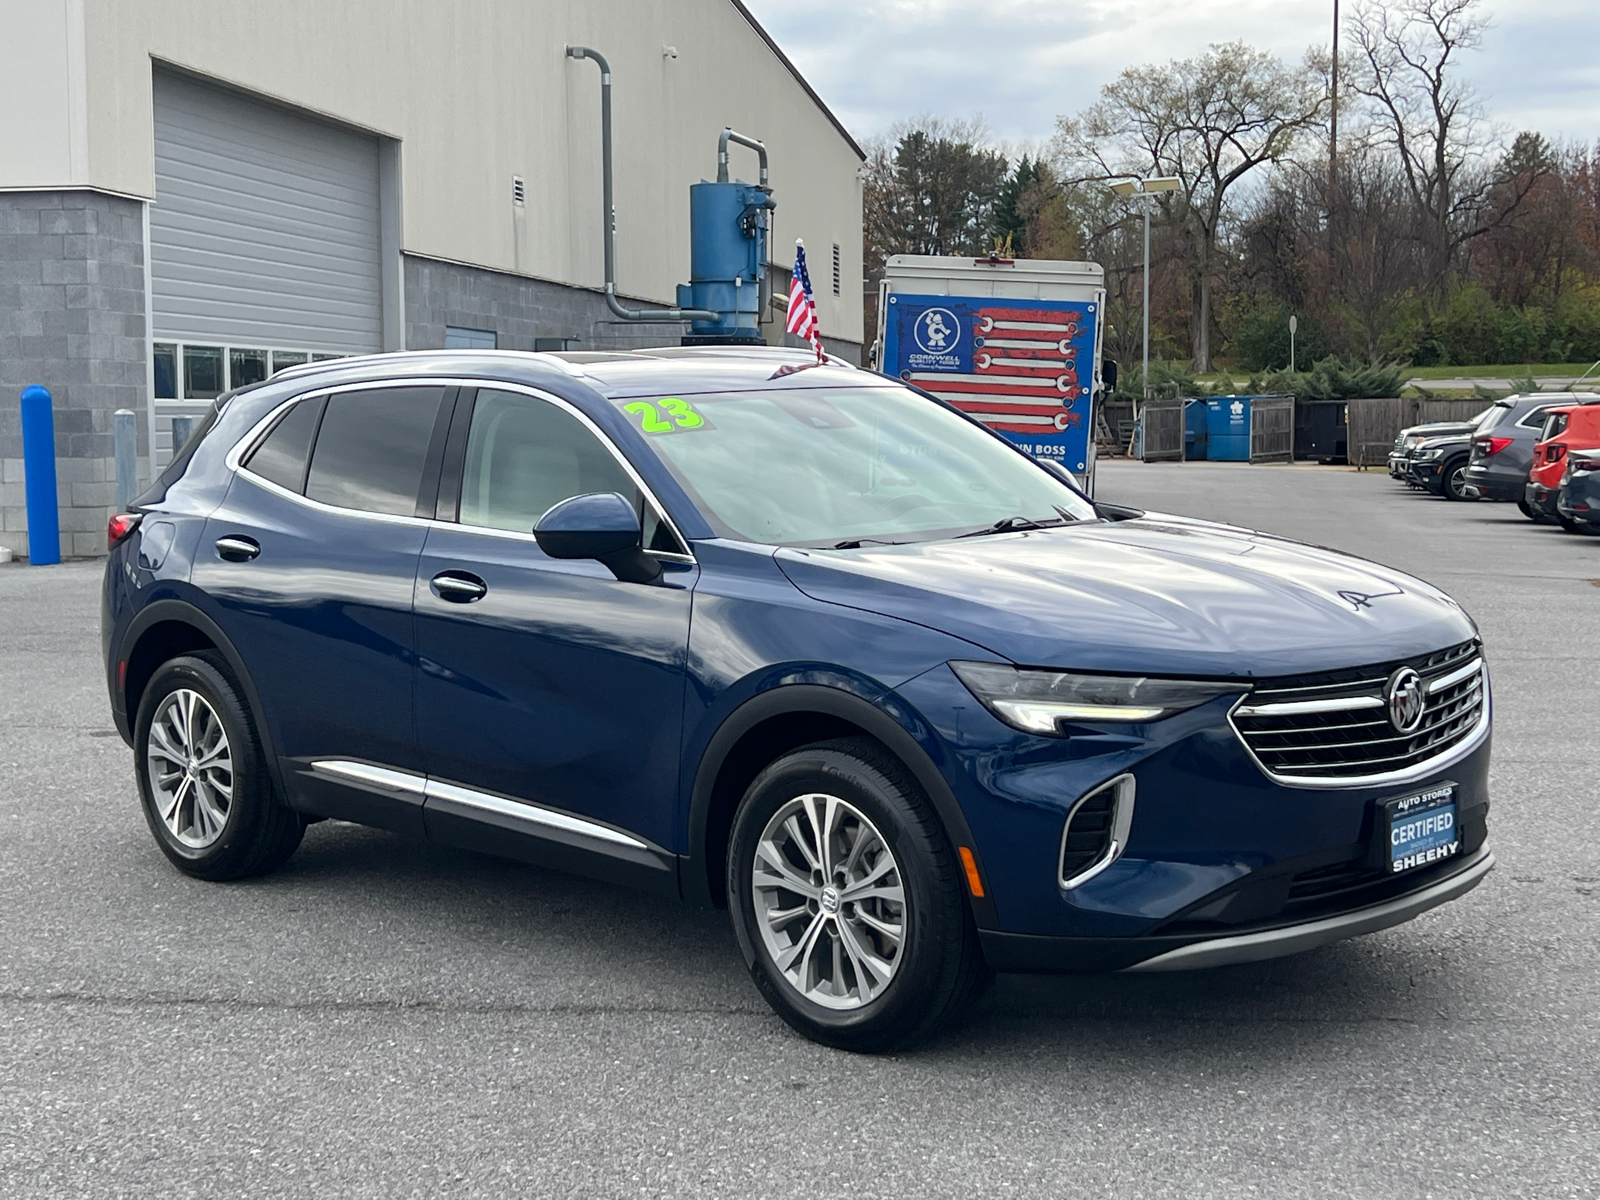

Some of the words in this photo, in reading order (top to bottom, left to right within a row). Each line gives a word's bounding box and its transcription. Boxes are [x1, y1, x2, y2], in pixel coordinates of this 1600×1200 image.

[623, 397, 705, 433] 23
[1035, 444, 1066, 456] BOSS
[1398, 796, 1421, 811] AUTO
[1421, 786, 1453, 803] STORES
[1391, 812, 1454, 846] CERTIFIED
[1393, 840, 1459, 872] SHEEHY
